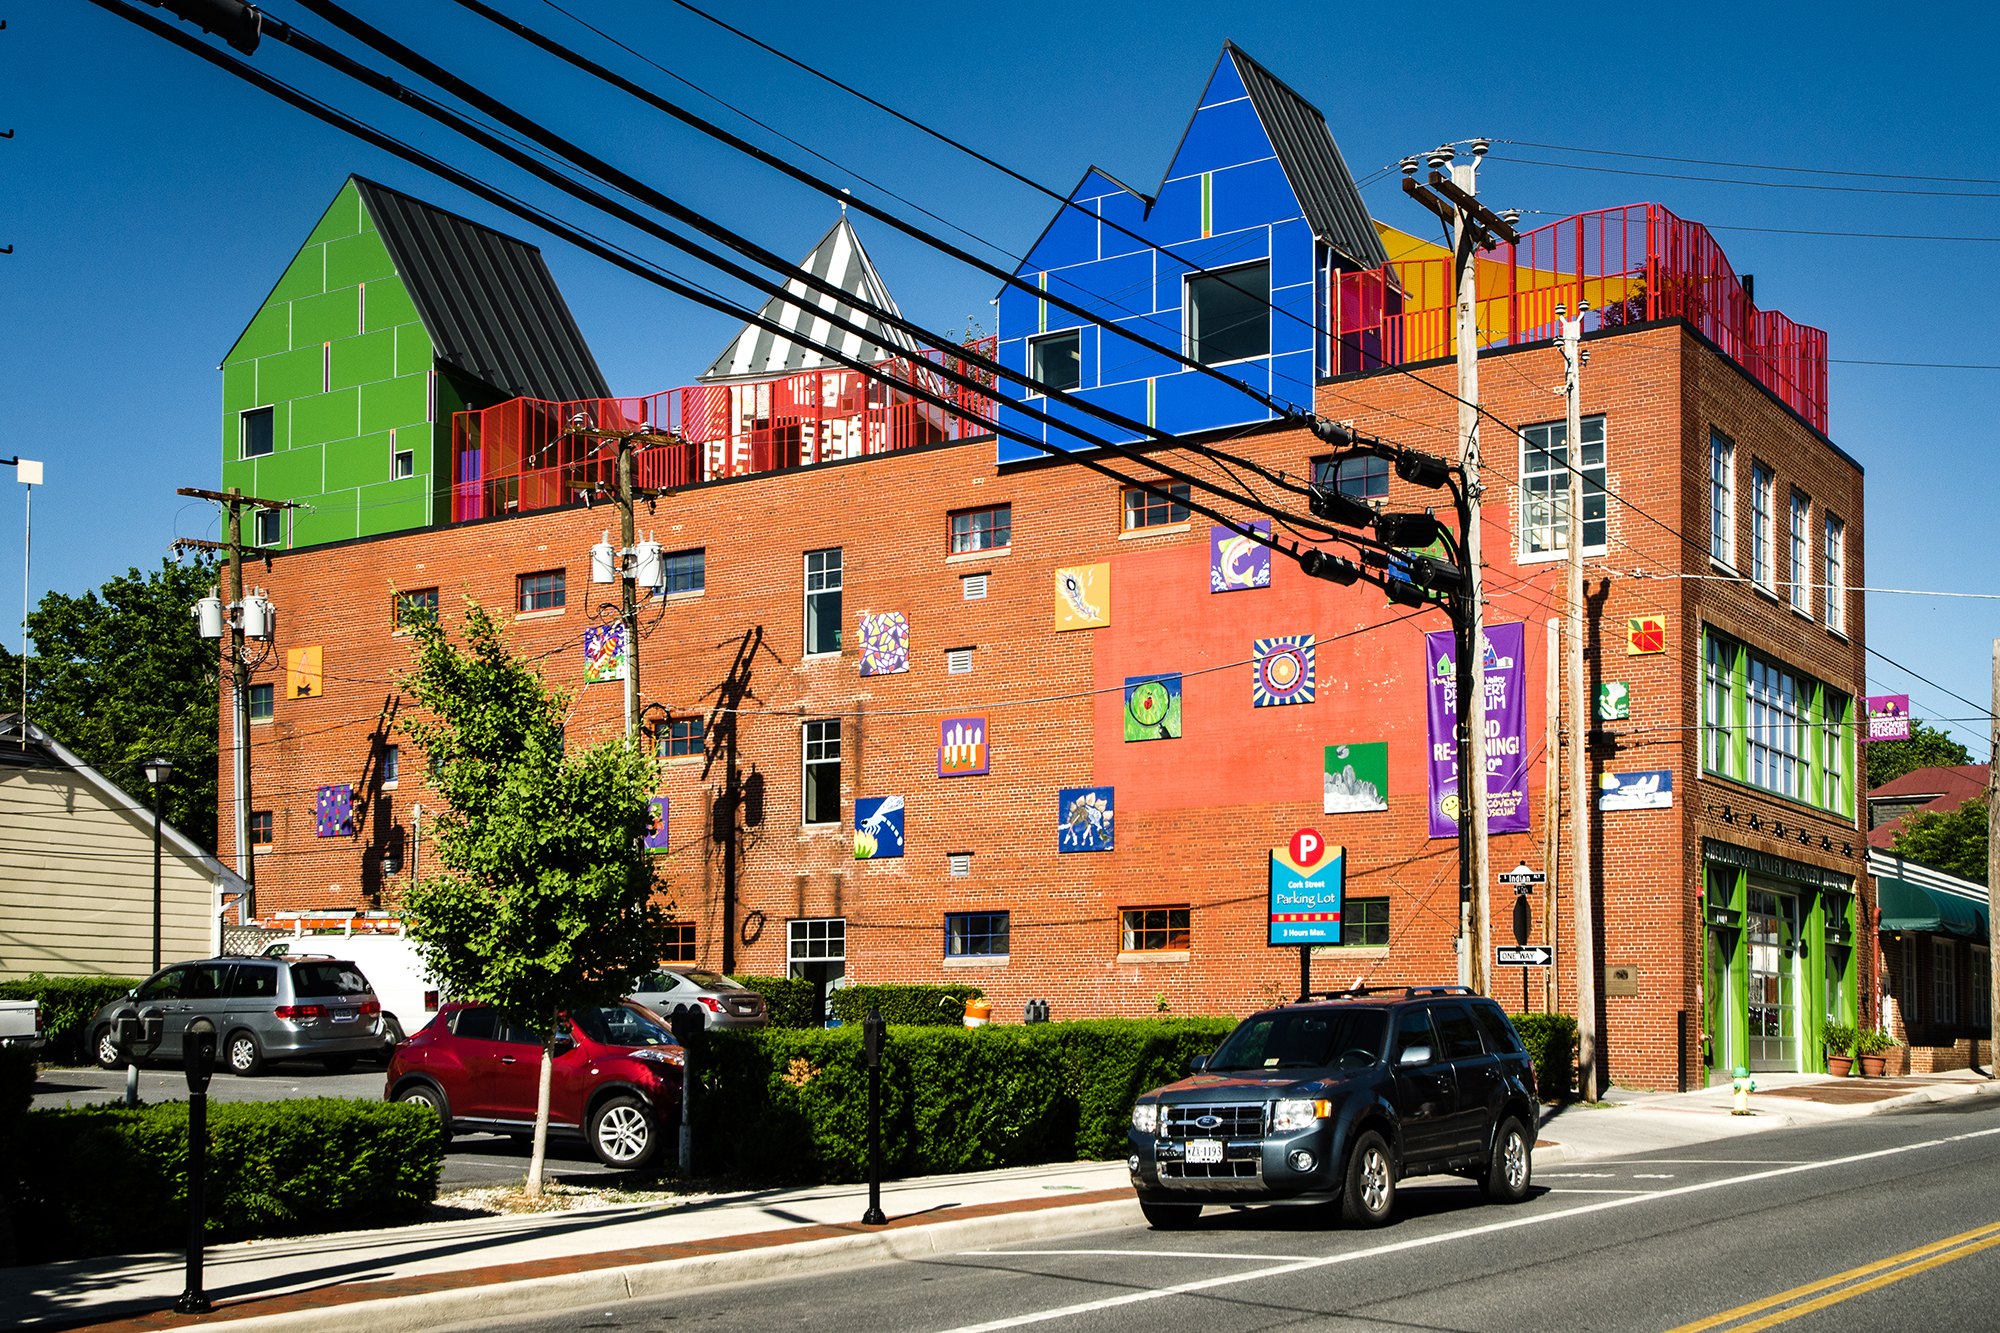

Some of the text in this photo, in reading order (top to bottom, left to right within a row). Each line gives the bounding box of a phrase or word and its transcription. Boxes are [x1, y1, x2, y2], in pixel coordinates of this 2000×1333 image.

[1870, 727, 1908, 738] MUSEUM
[1300, 834, 1318, 862] P
[1705, 842, 1756, 868] SHENANDOAH
[1758, 855, 1783, 876] VALLEY
[1785, 862, 1820, 885] DISCOVERY
[1509, 874, 1531, 883] Indian
[1288, 881, 1303, 889] Cork
[1277, 891, 1336, 909] Parking Lot
[1283, 929, 1326, 937] 3 Hours Max.
[1502, 952, 1535, 960] ONE WAY
